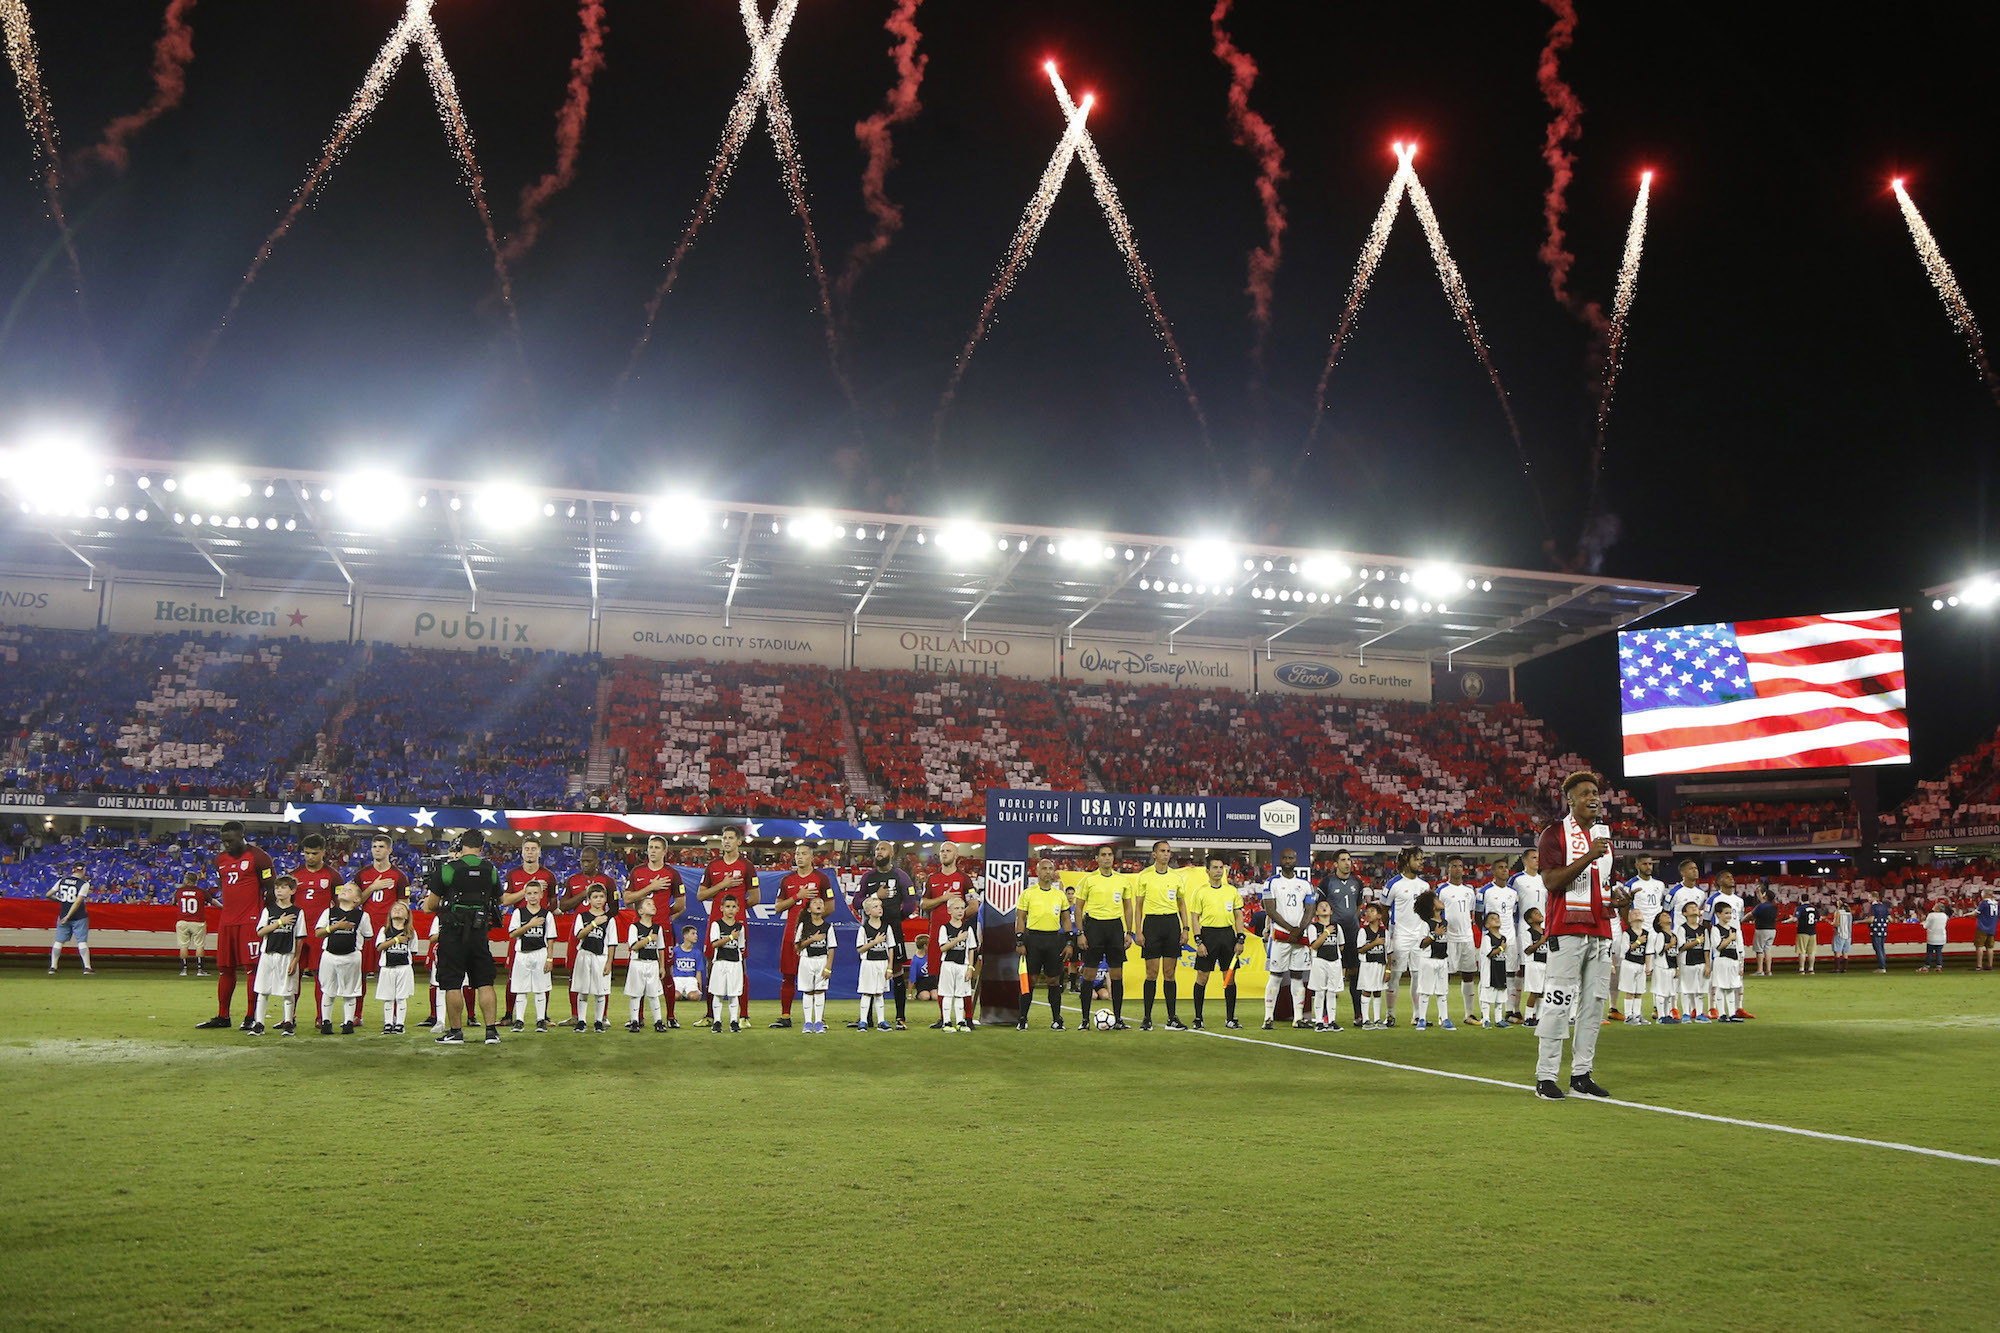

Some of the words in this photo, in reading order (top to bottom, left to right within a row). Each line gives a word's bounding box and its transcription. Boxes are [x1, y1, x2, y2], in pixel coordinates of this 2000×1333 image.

[0, 591, 49, 609] NDS
[154, 600, 277, 627] Heineken
[415, 612, 529, 642] Publix
[633, 631, 708, 646] ORLANDO
[712, 635, 744, 648] CITY
[749, 637, 812, 651] STADIUM
[900, 631, 1011, 656] ORLANDO
[914, 653, 998, 676] HEALTH
[1186, 660, 1230, 677] World
[1287, 663, 1328, 687] Ford
[1350, 673, 1366, 685] Go
[1369, 674, 1412, 687] Further
[98, 796, 123, 808] ONE
[127, 797, 178, 810] NATION.
[182, 799, 207, 811] ONE
[211, 800, 249, 812] TEAM.
[998, 798, 1034, 809] WORLD
[1040, 799, 1059, 810] CUP
[1081, 798, 1111, 816] USA
[1118, 800, 1136, 817] VS
[1143, 801, 1206, 818] PANAMA
[998, 811, 1059, 823] QUALIFYING
[1081, 816, 1123, 827] 10.06.17
[1143, 818, 1191, 829] ORLANDO,
[1195, 819, 1206, 829] FL
[1263, 811, 1296, 824] VOLPI
[1315, 834, 1339, 844] ROAD
[1341, 834, 1352, 844] TO
[1354, 835, 1387, 845] RUSSIA
[1925, 828, 1953, 839] ACION.
[1954, 828, 1967, 838] UN
[1424, 836, 1442, 846] UNA
[1477, 837, 1490, 847] UN
[1490, 837, 1522, 847] EQUIPO.
[227, 872, 239, 885] 17
[989, 863, 1022, 884] USA
[60, 884, 77, 903] 58
[306, 889, 315, 900] 2
[372, 890, 384, 902] 10
[1286, 893, 1297, 907] 23
[1647, 894, 1657, 906] 20
[180, 898, 198, 914] 10
[1344, 895, 1349, 909] 1
[1458, 900, 1466, 912] 17
[1501, 901, 1507, 914] 8
[1990, 904, 1999, 916] 14
[1808, 912, 1815, 925] 8
[248, 941, 260, 956] 17
